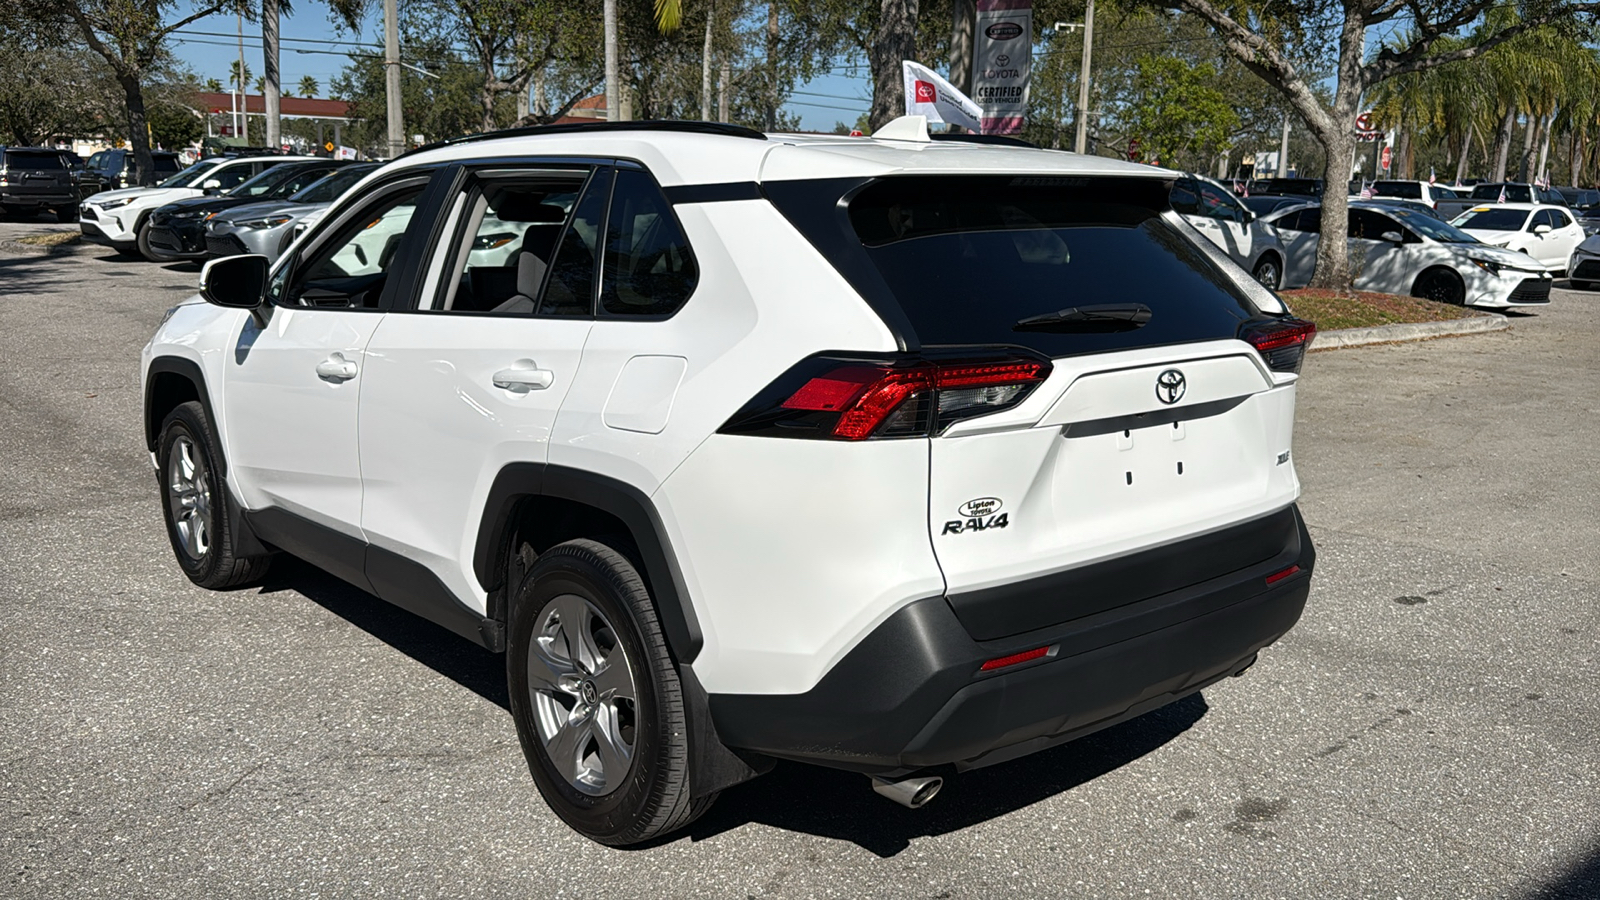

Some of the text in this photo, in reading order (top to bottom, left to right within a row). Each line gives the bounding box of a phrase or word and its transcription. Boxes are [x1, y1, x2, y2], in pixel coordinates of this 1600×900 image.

[981, 69, 1019, 79] TOYOTA
[978, 86, 1023, 98] CERTIFIED
[967, 500, 995, 510] Lipton
[941, 512, 1009, 536] RAV4
